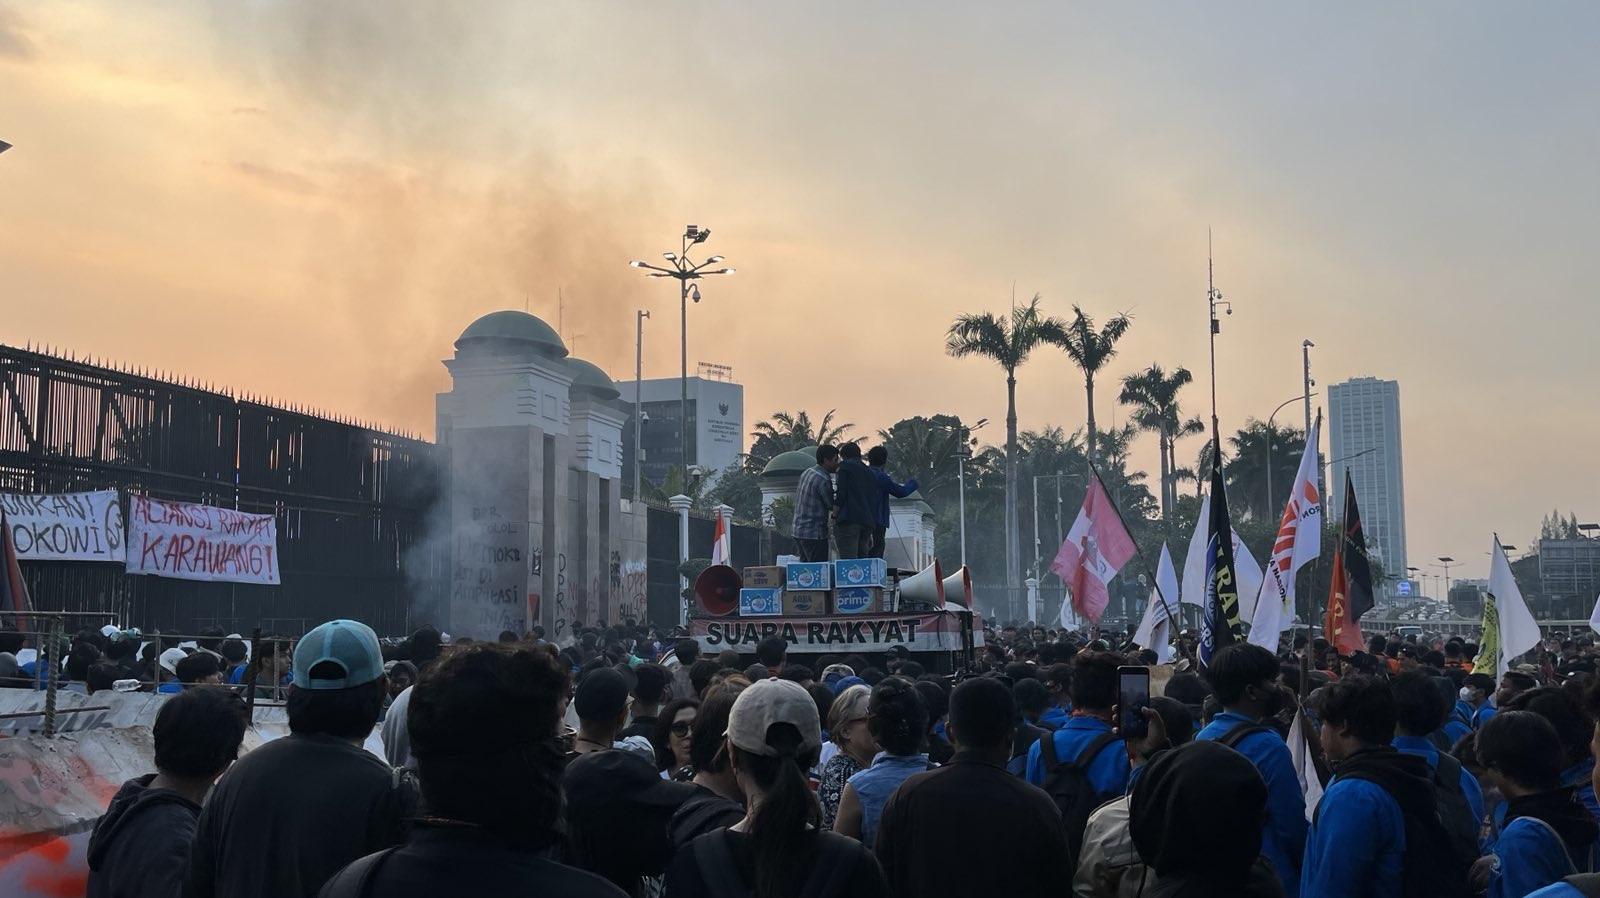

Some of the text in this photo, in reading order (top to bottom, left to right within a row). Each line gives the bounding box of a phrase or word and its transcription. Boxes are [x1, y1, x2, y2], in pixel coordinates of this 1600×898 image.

[1, 494, 96, 523] UNKAN!
[13, 522, 105, 554] OKOWI
[140, 532, 273, 581] KARAWANG!
[705, 619, 922, 645] SUARA RAKYAT
